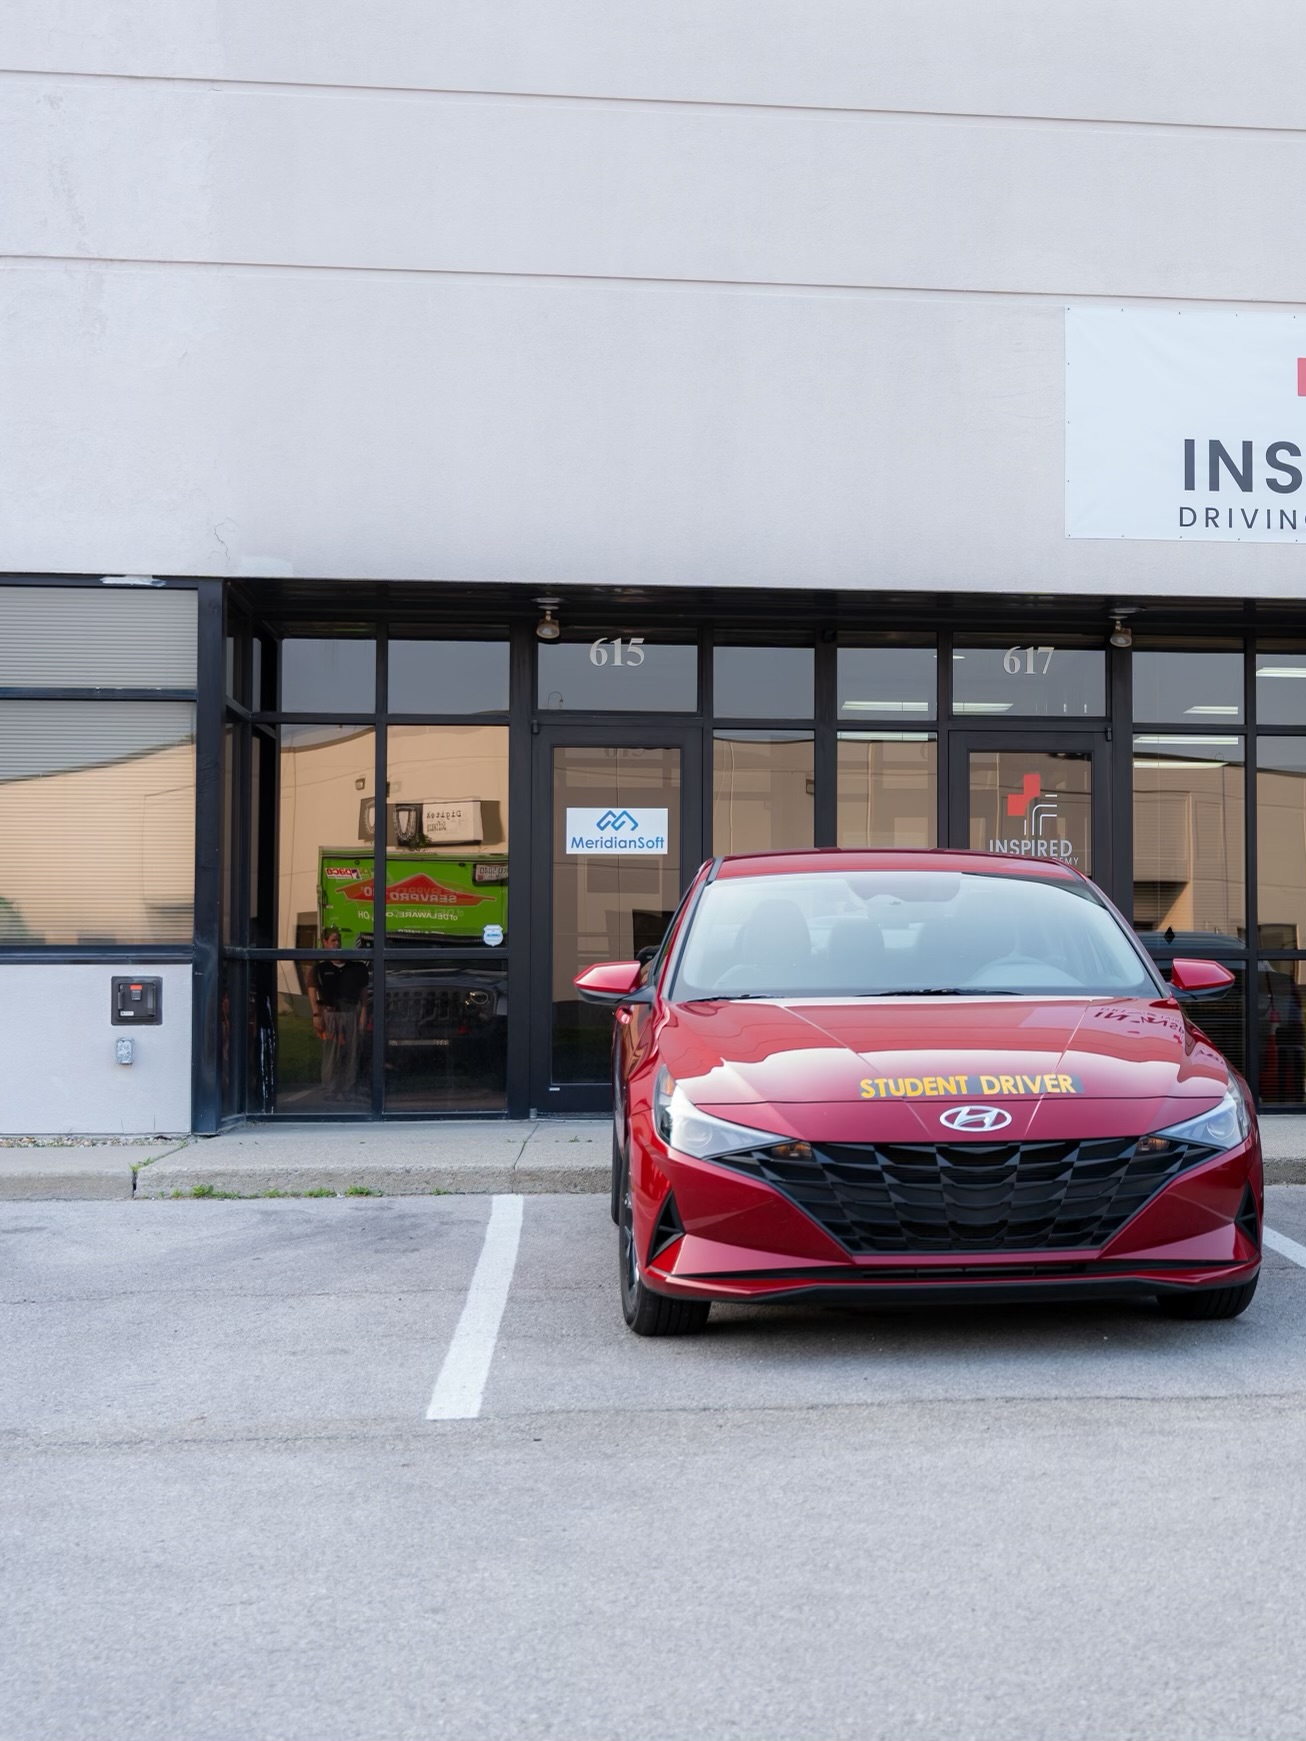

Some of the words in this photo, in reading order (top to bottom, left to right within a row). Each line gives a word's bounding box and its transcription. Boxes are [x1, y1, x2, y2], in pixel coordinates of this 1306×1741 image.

[589, 637, 646, 668] 615
[1002, 646, 1055, 676] 617
[570, 834, 665, 853] MeridianSoft
[989, 839, 1073, 857] INSPIRED
[860, 1075, 968, 1099] STUDENT
[979, 1073, 1077, 1095] DRIVER
